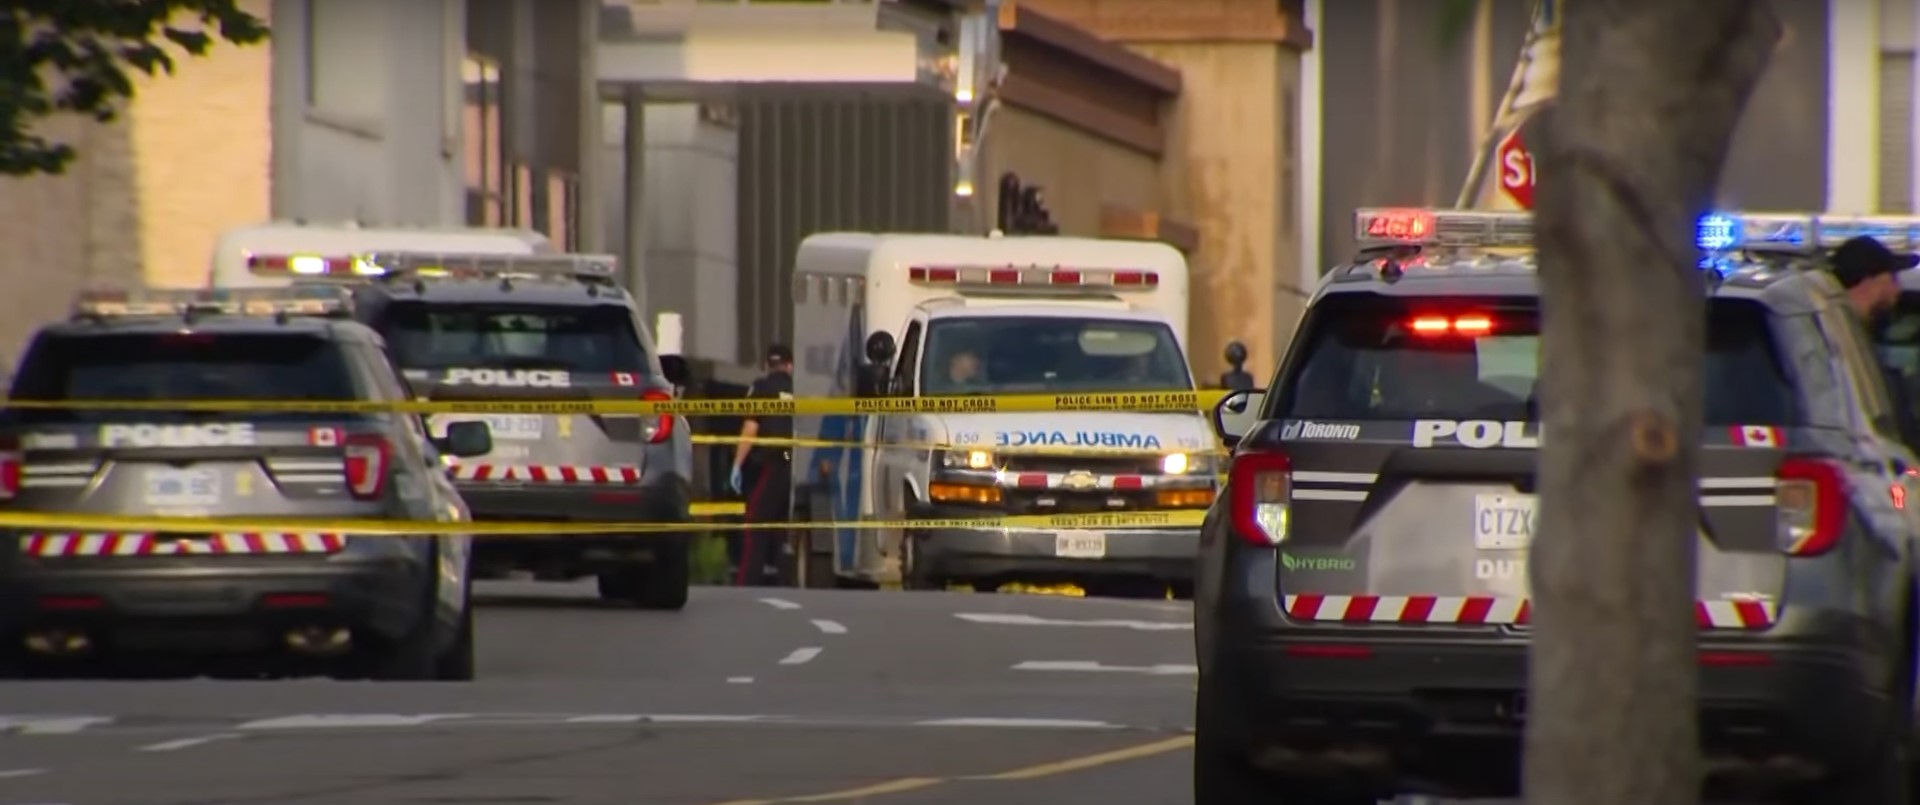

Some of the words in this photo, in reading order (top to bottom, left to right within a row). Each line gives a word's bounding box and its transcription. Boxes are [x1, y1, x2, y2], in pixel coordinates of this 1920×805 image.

[1504, 148, 1537, 188] ST
[441, 367, 571, 387] POLICE
[653, 402, 689, 410] POLICE
[762, 401, 796, 409] CROSS
[854, 400, 889, 408] POLICE
[895, 400, 917, 408] LINE
[922, 399, 935, 408] DO
[939, 399, 958, 407] NOT
[962, 398, 996, 407] CROSS
[1055, 396, 1091, 405] POLICE
[1095, 396, 1118, 405] LINE
[1122, 395, 1136, 404] DO
[1140, 395, 1160, 403] NOT
[1164, 394, 1197, 403] CROSS
[102, 423, 255, 447] POLICE
[1300, 421, 1361, 440] TORONTO
[1412, 419, 1538, 448] POL
[1295, 553, 1356, 570] HYBRID
